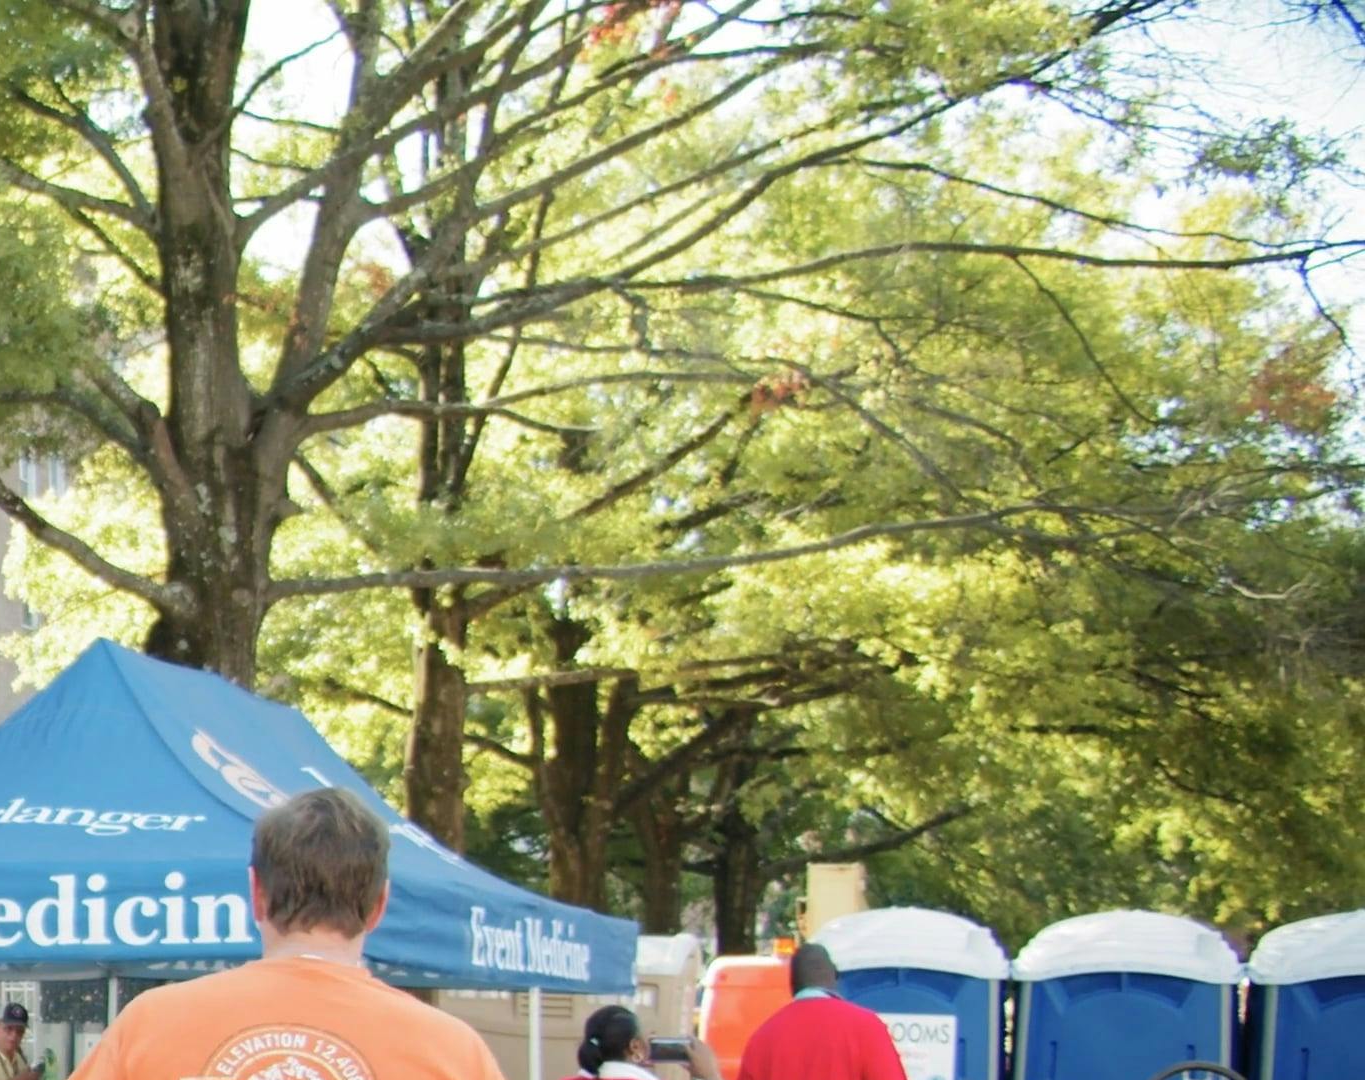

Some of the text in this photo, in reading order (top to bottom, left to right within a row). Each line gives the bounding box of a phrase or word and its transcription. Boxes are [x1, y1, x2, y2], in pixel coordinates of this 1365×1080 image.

[470, 906, 590, 981] Event Medicine
[216, 1032, 307, 1076] ELEVATION
[891, 1022, 950, 1045] OOMS
